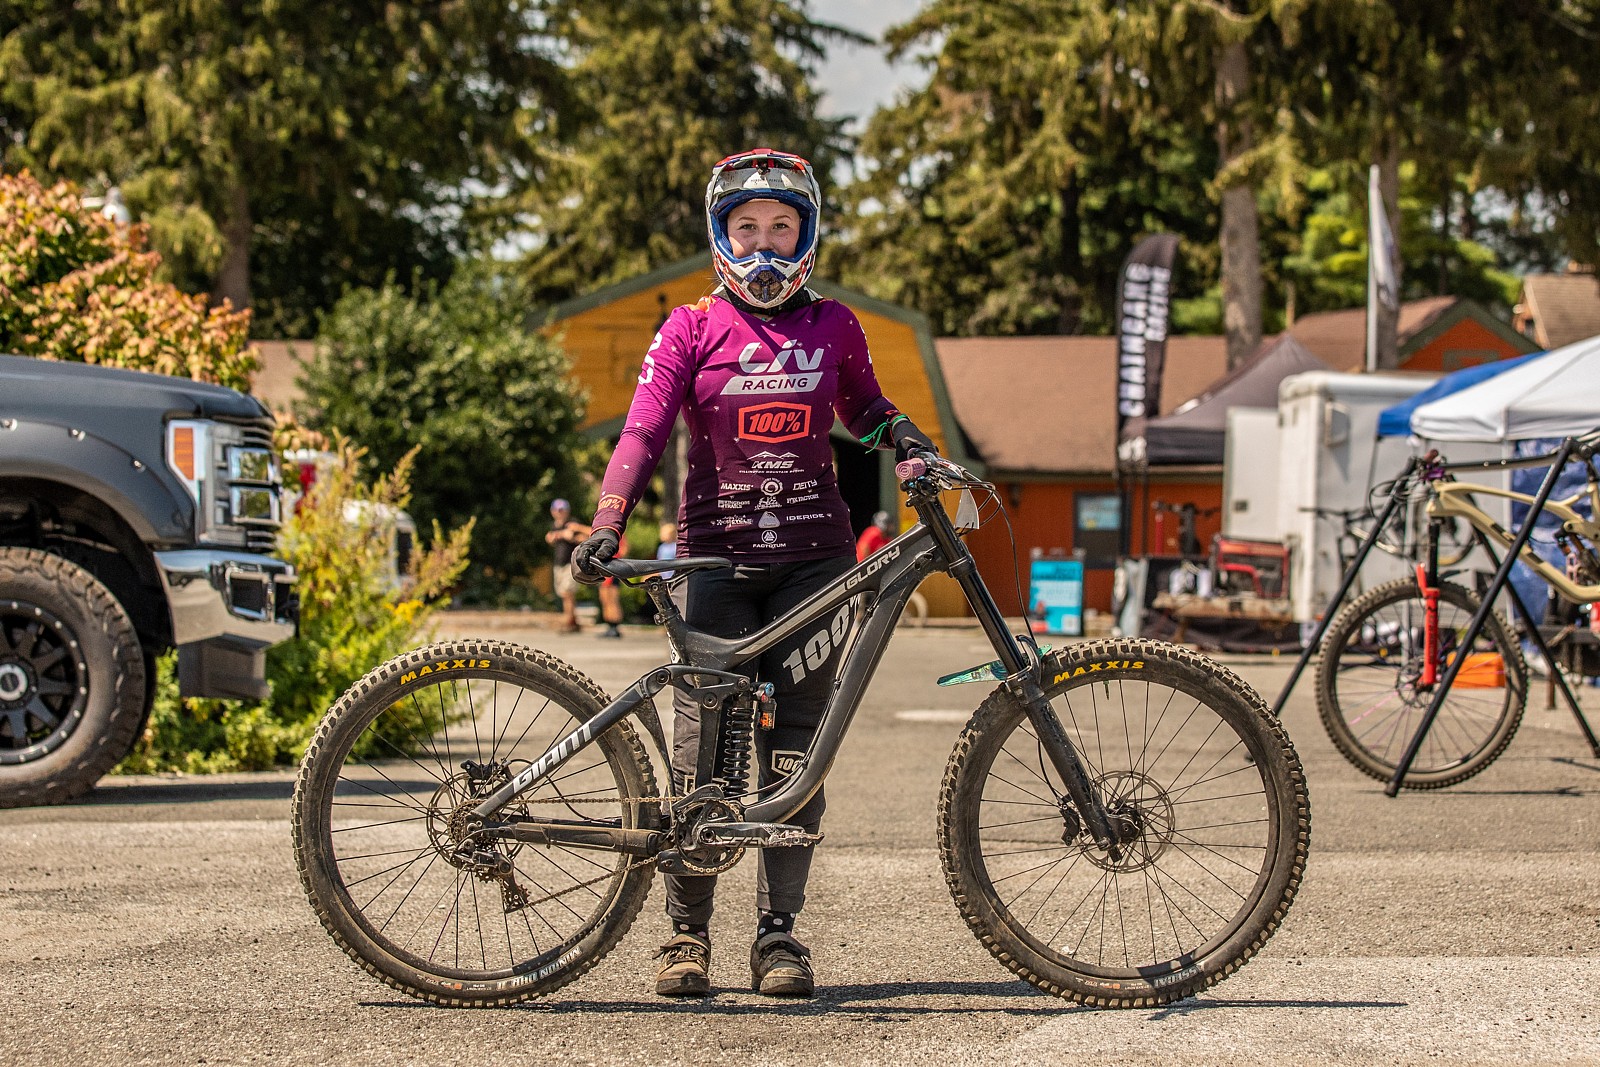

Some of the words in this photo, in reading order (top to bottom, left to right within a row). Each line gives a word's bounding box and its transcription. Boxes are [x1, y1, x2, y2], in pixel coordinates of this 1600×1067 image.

[742, 378, 808, 391] RACING
[749, 412, 801, 433] 100%
[751, 461, 795, 469] KMS
[720, 482, 752, 491] MAXXIS
[786, 513, 825, 521] IDERIDE
[846, 546, 901, 590] GLORY
[400, 659, 491, 685] MAXXIS
[1053, 660, 1145, 685] MAXXIS
[512, 716, 596, 794] GIANT
